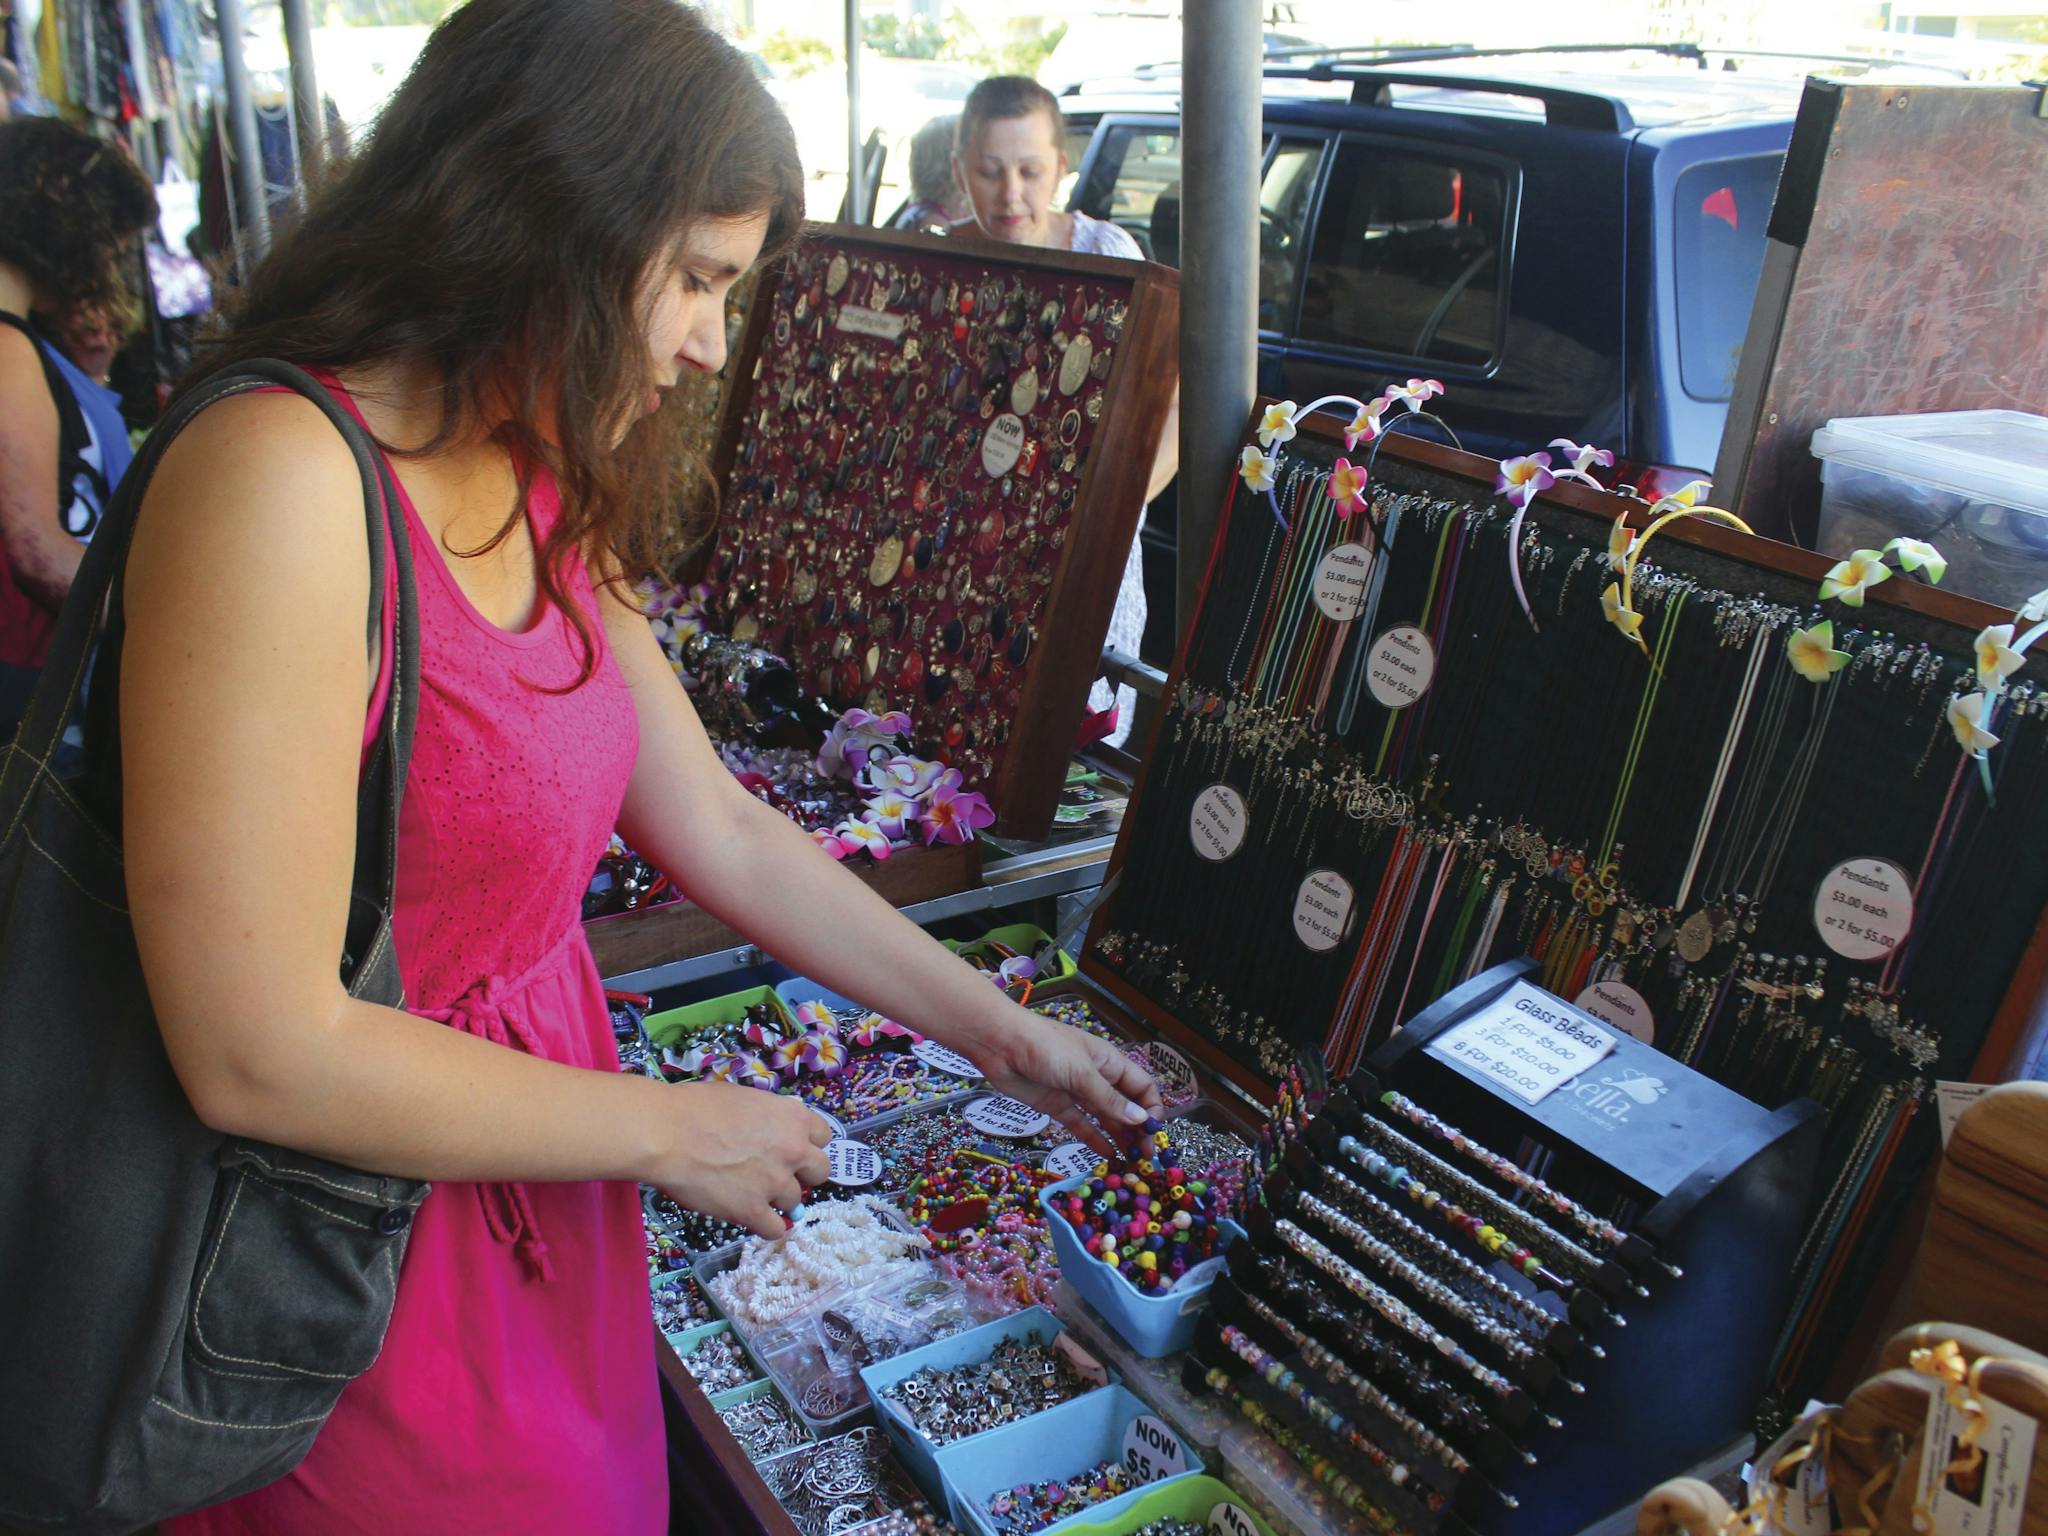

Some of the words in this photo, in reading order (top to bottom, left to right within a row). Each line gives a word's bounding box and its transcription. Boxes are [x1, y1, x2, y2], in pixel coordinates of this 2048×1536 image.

[996, 418, 1020, 437] NOW
[1331, 553, 1364, 567] Pendants
[1326, 571, 1346, 583] $3.00
[1347, 577, 1364, 586] each
[1330, 592, 1336, 600] 2
[1337, 593, 1348, 603] for
[1389, 633, 1421, 655] Pendants
[1381, 650, 1400, 666] $3.00
[1400, 662, 1416, 675] each
[1381, 673, 1387, 681] 2
[1386, 676, 1397, 687] for
[1397, 682, 1418, 699] $5.00
[1213, 788, 1236, 817] Pendants
[1203, 802, 1219, 821] $3.00
[1217, 820, 1230, 835] each
[1201, 824, 1206, 832] 2
[1204, 828, 1214, 840] for
[1211, 838, 1227, 857] $5.00
[1310, 878, 1341, 899] Pendants
[1841, 867, 1889, 892] Pendants
[1304, 895, 1323, 910] $3.00
[1323, 907, 1339, 919] each
[1832, 891, 1861, 909] $3.00
[1862, 903, 1888, 919] each
[1305, 917, 1312, 926] 2
[1312, 919, 1322, 932] for
[1825, 916, 1836, 926] or
[1838, 919, 1846, 930] 2
[1846, 922, 1862, 936] for
[1863, 928, 1895, 948] $5.00
[1594, 986, 1636, 1016] Pendants
[1515, 998, 1556, 1024] Glass
[1554, 1017, 1603, 1049] Beads
[1500, 1017, 1511, 1026] 1
[1536, 1036, 1576, 1060] $5.00
[1149, 1041, 1191, 1084] BRACELETS
[1475, 1028, 1484, 1036] 3
[1511, 1047, 1560, 1075] $10.00
[1490, 1061, 1540, 1091] $20.00
[981, 1106, 1007, 1118] $3.00
[1006, 1115, 1029, 1126] each
[986, 1096, 1043, 1121] BRACELETS
[984, 1118, 998, 1126] for
[997, 1122, 1025, 1135] $5.00
[856, 1147, 874, 1180] BRACELETS
[1051, 1157, 1061, 1165] or
[1068, 1154, 1088, 1173] $3.00
[1136, 1418, 1176, 1460] NOW
